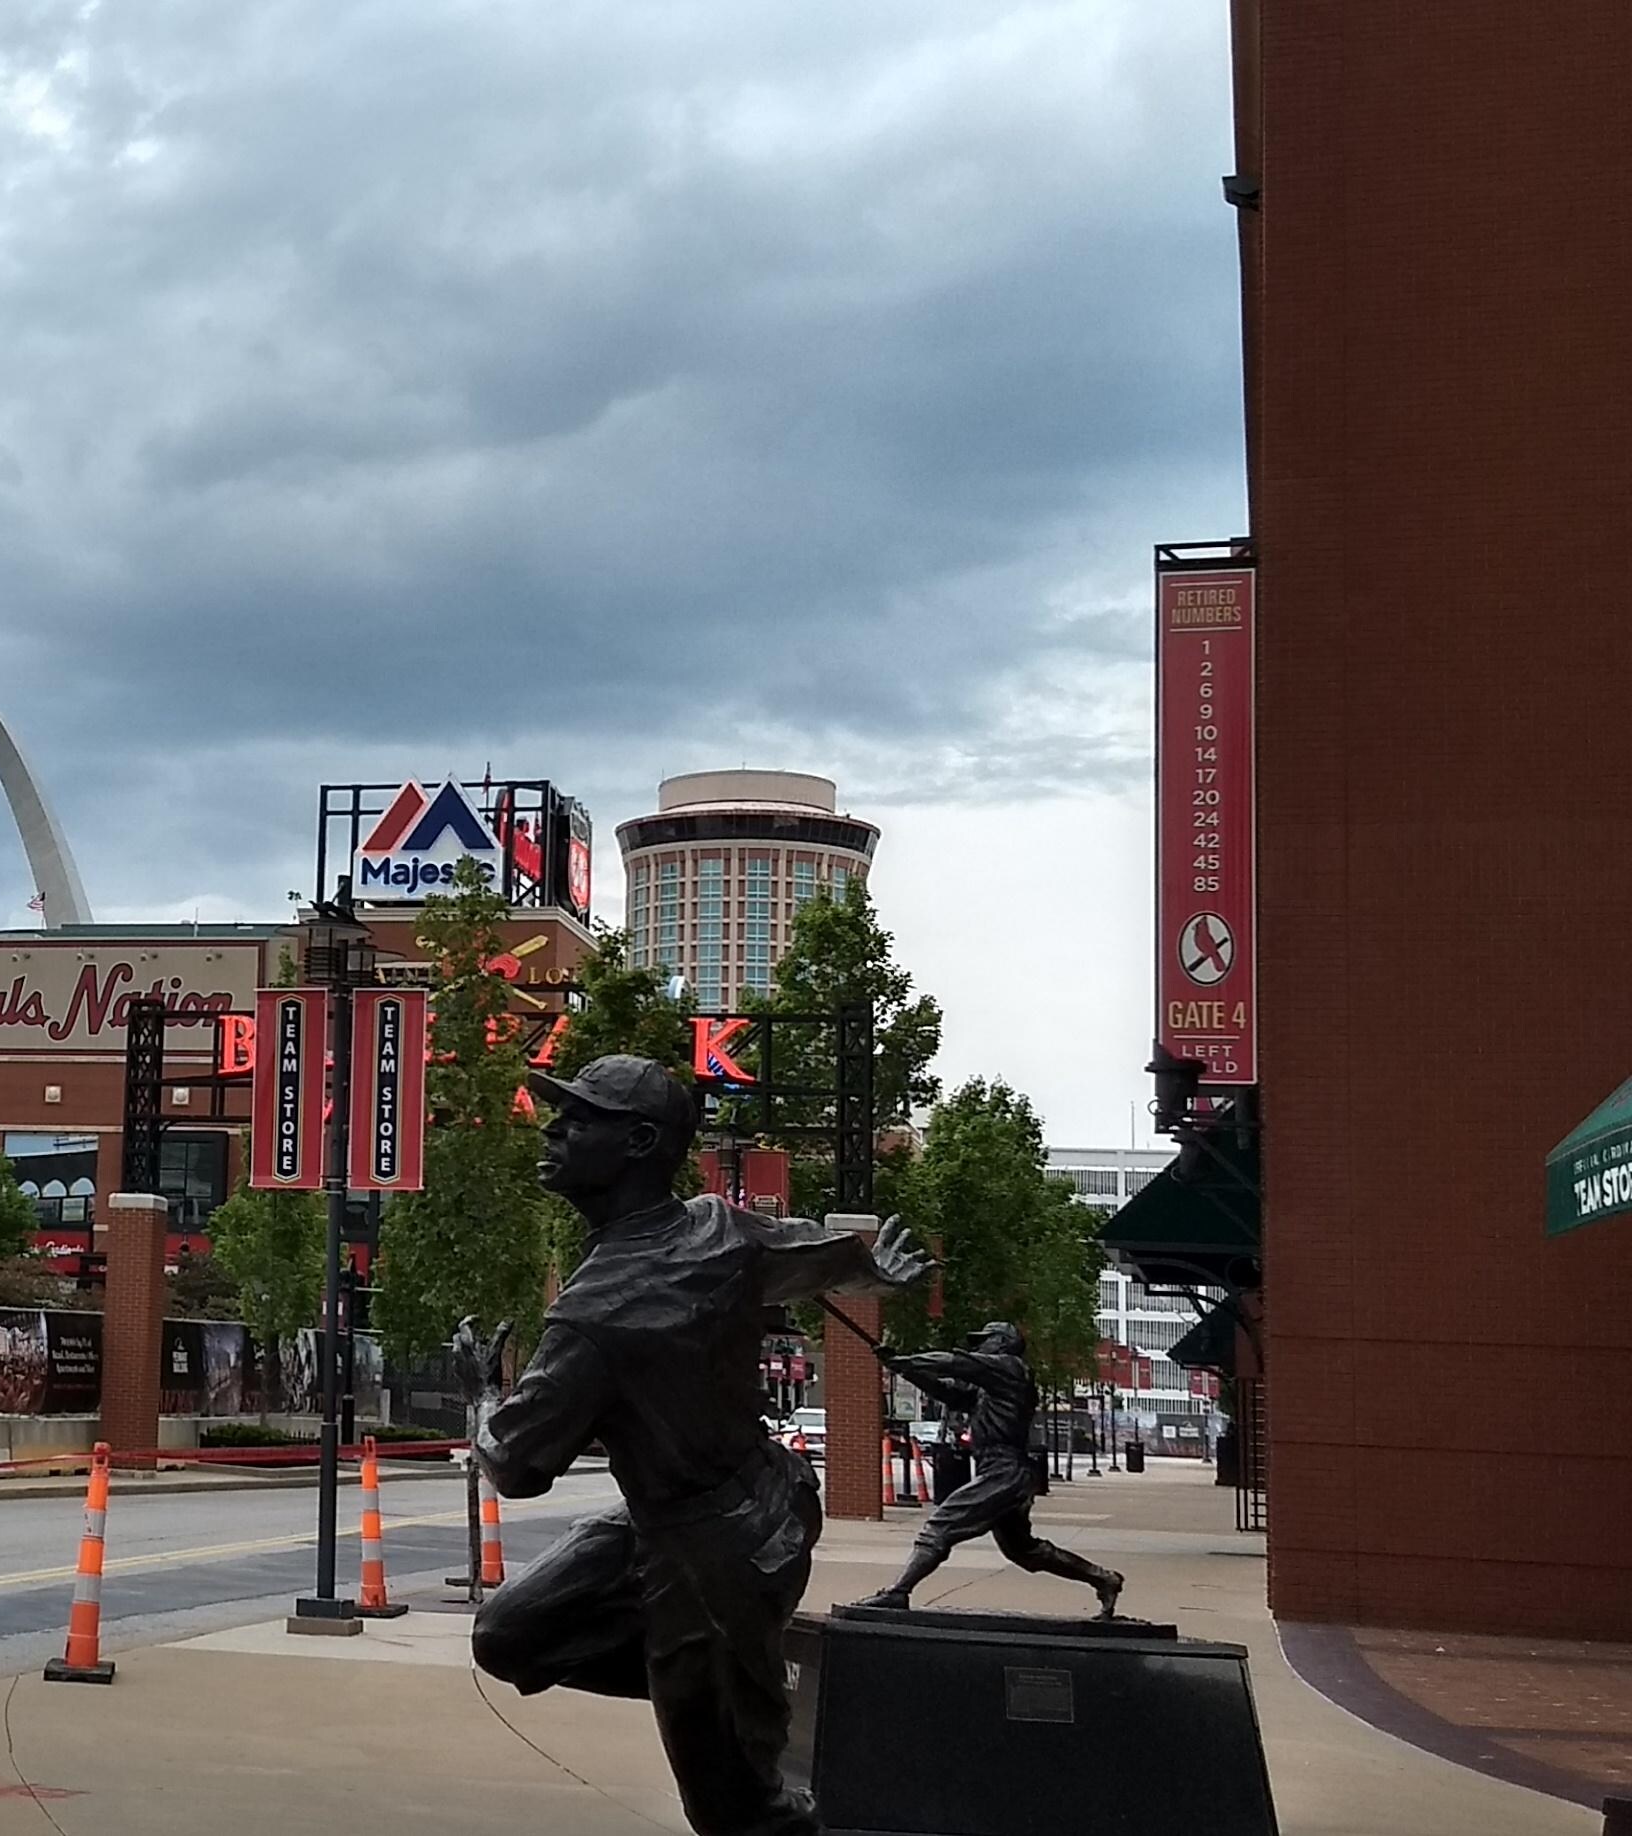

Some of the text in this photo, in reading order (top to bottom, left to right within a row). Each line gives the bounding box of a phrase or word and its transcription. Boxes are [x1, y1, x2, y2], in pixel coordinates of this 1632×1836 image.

[1177, 588, 1236, 606] RETIRED
[1171, 605, 1242, 625] NUMBERS
[1201, 640, 1211, 655] 1
[1200, 661, 1213, 677] 2
[1199, 682, 1213, 699] 6
[1199, 703, 1213, 719] 9
[1194, 725, 1218, 741] 10
[1194, 747, 1218, 763] 14
[1195, 768, 1217, 784] 17
[1192, 789, 1220, 806] 20
[1192, 811, 1220, 828] 24
[1192, 832, 1220, 849] 42
[1192, 854, 1220, 871] 45
[360, 856, 496, 894] Majesc
[1193, 876, 1220, 892] 85
[1167, 1001, 1247, 1030] GATE 4
[1181, 1044, 1234, 1058] LEFT
[281, 1006, 298, 1171] TEAM STORE
[378, 1006, 396, 1172] TEAM STORE
